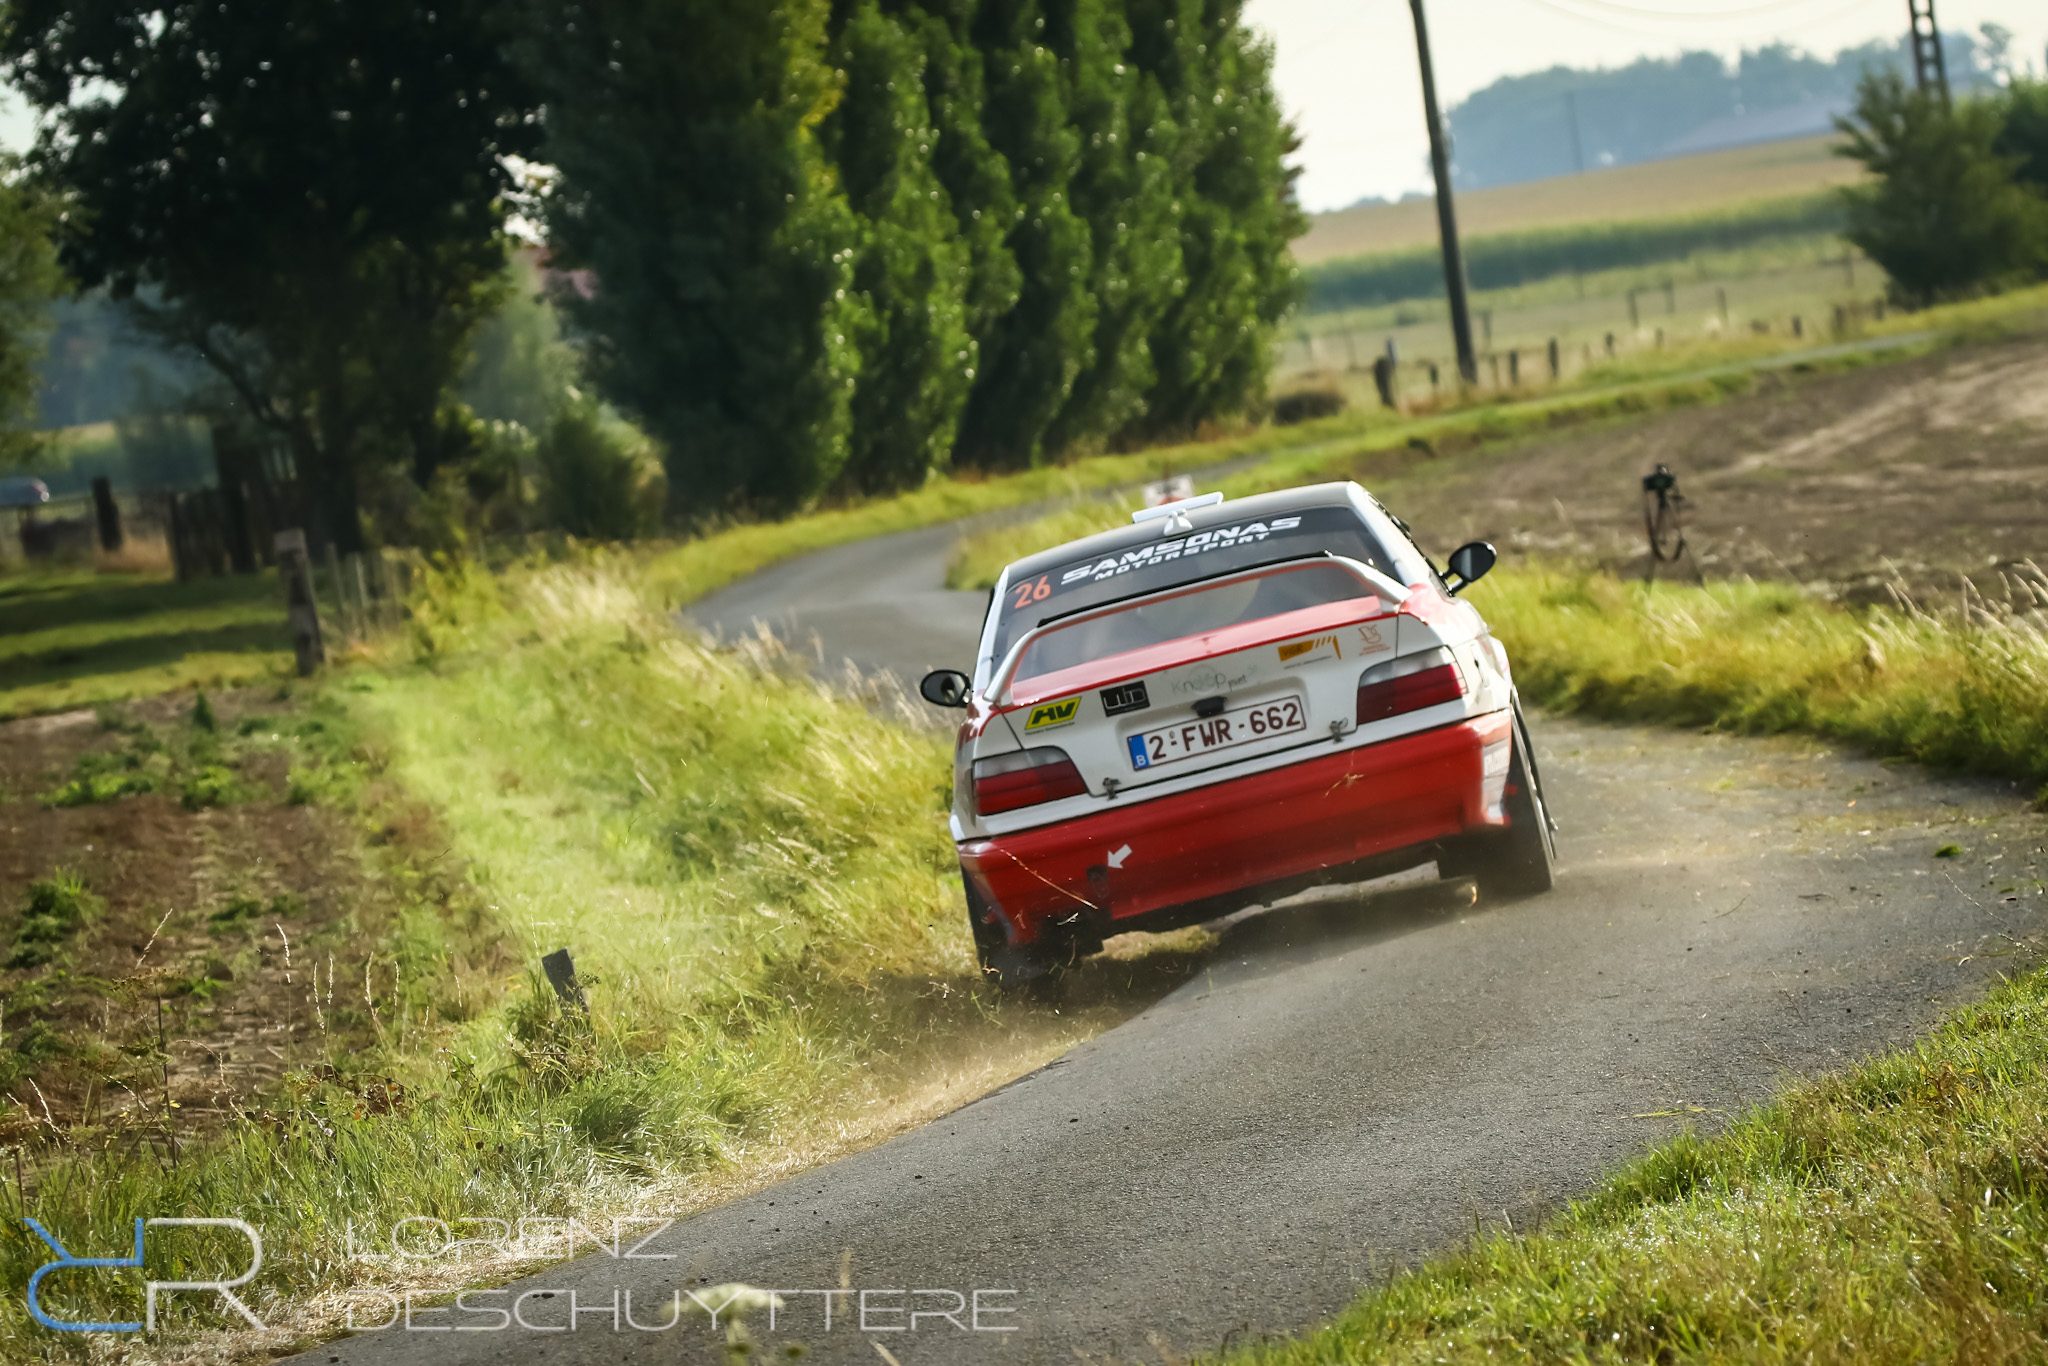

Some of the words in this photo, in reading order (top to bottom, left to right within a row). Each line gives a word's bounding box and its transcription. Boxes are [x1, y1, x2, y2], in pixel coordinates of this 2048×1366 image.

[1061, 516, 1302, 585] SAMSONAS
[1095, 532, 1271, 581] MOTORSPORT
[1014, 575, 1051, 609] 26
[1032, 701, 1077, 725] HV
[1135, 754, 1147, 766] B
